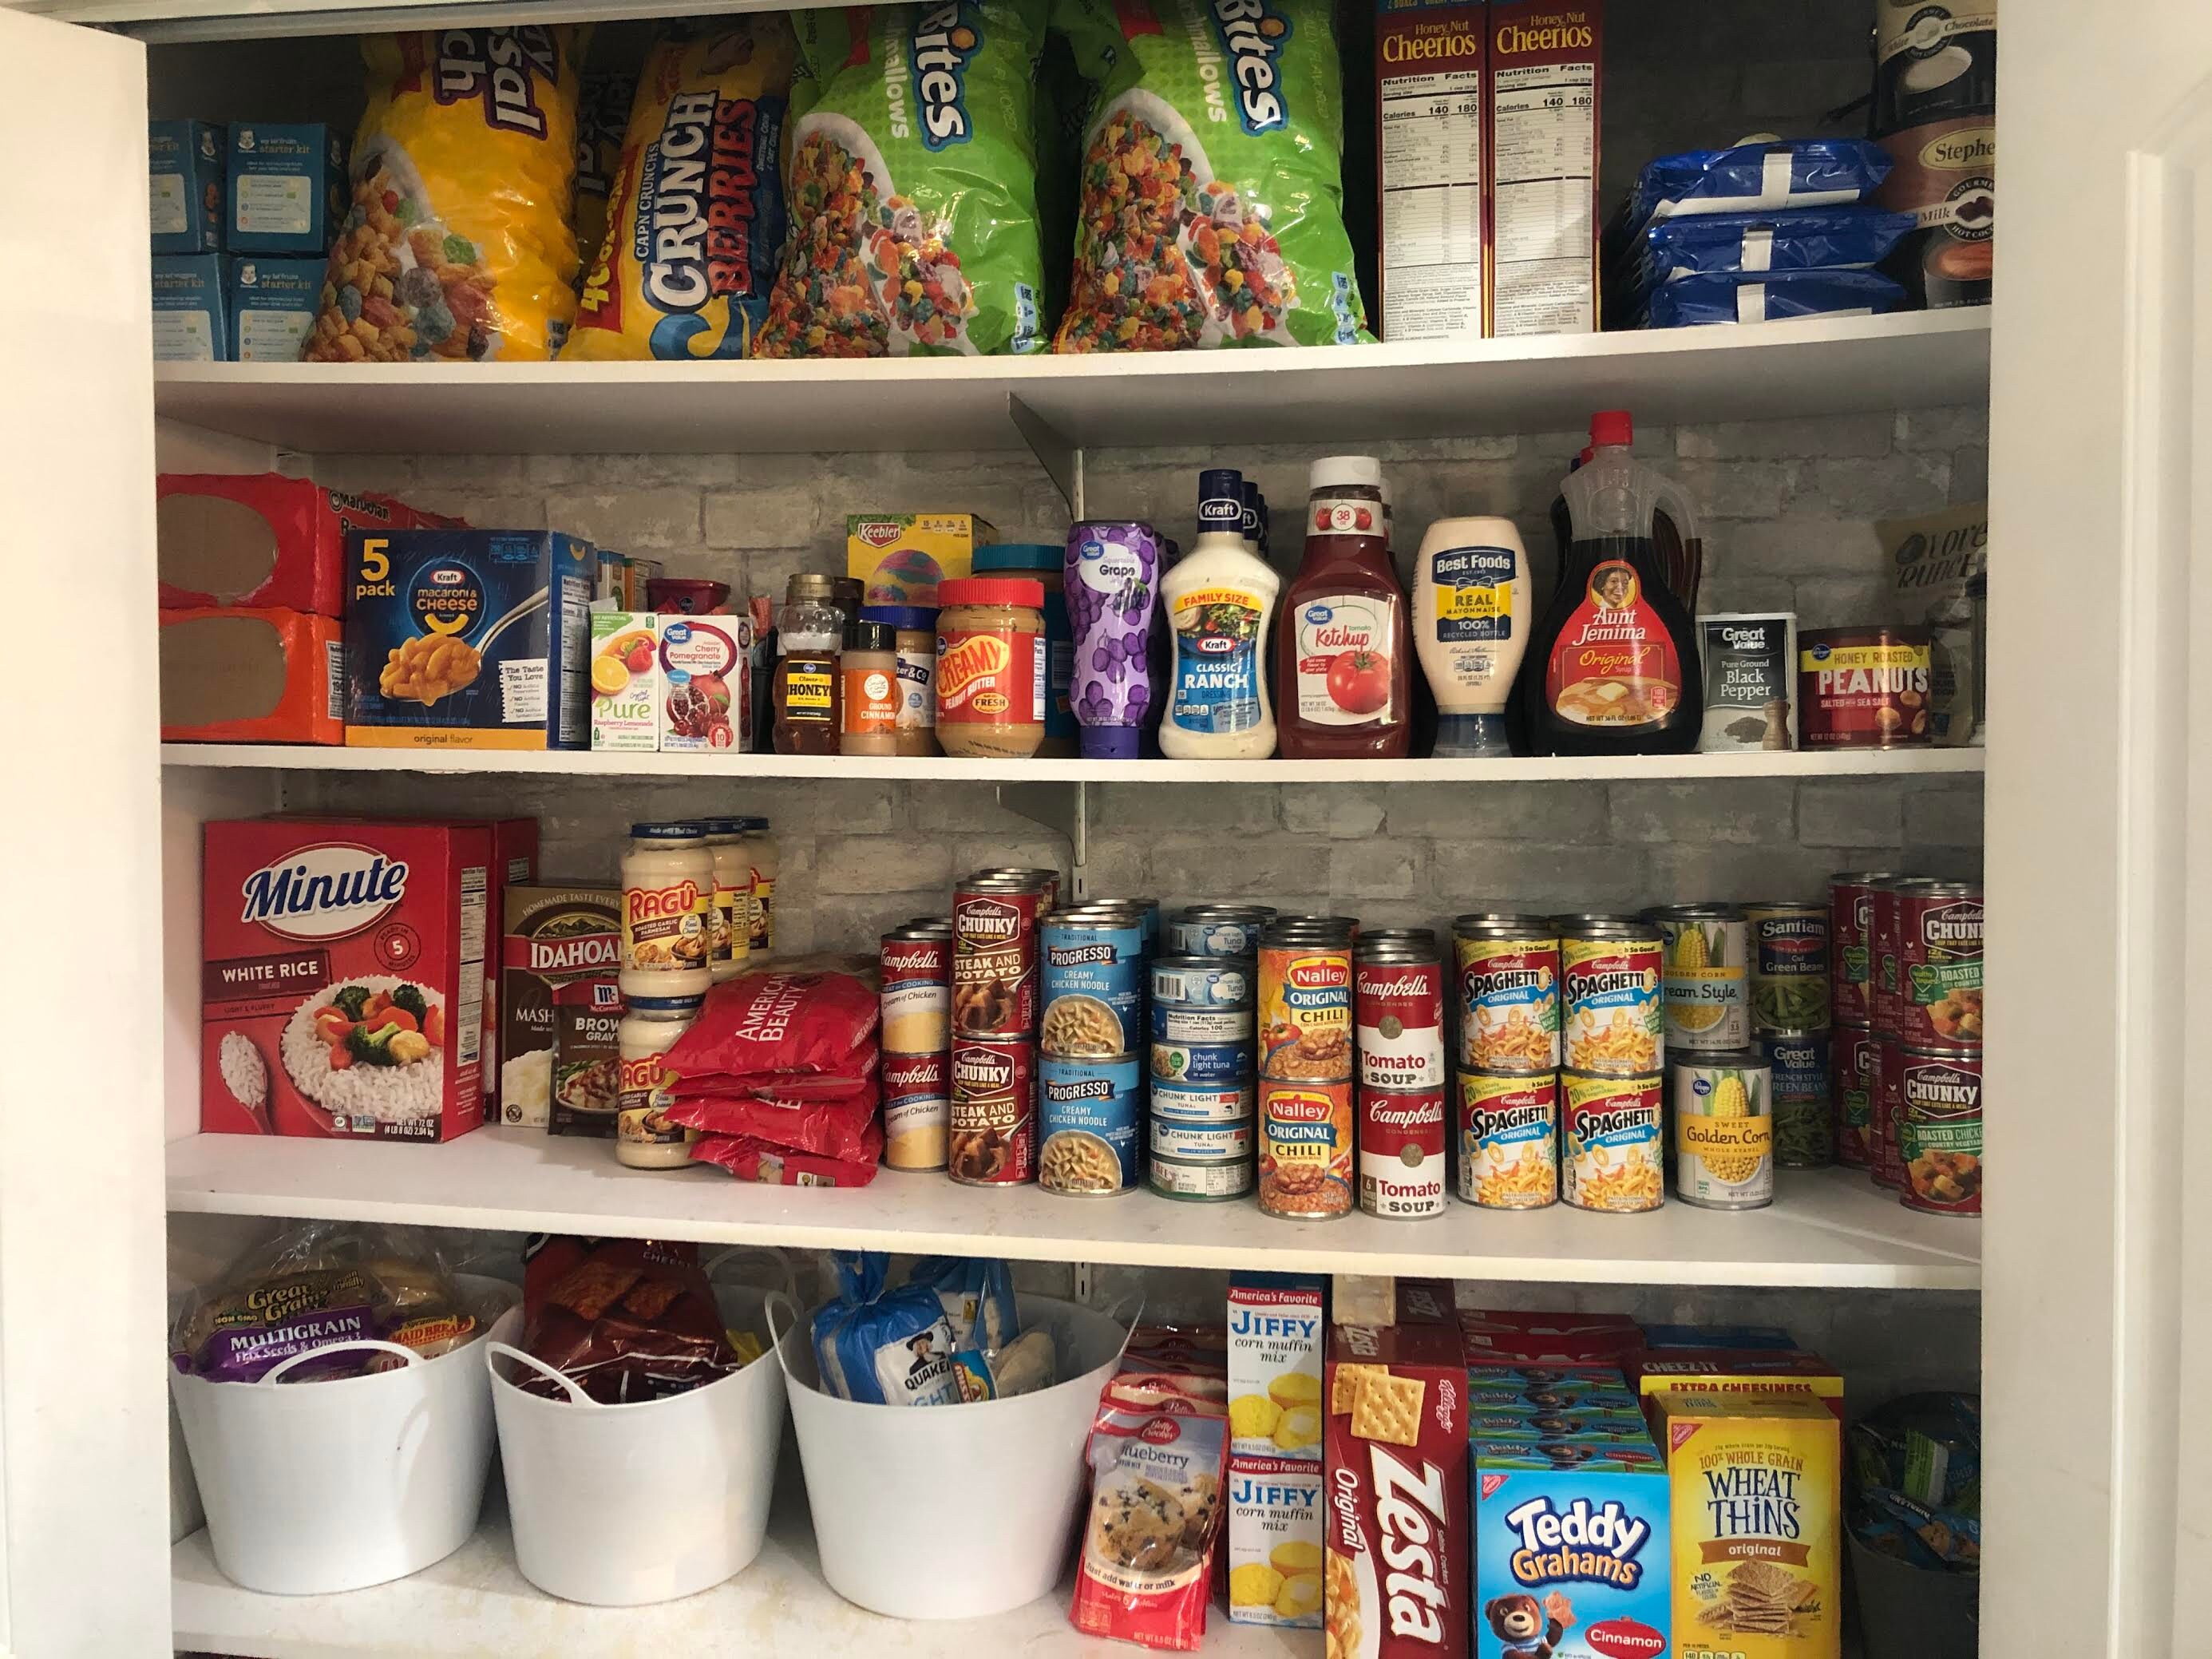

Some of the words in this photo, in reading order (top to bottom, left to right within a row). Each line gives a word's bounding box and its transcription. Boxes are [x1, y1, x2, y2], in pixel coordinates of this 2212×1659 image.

[1945, 18, 1993, 32] Chocolate
[1497, 26, 1593, 54] Cheerios
[1383, 34, 1476, 62] Cheerios
[1383, 75, 1434, 86] Nutrition
[1445, 72, 1477, 81] Facts
[1496, 66, 1549, 78] Nutrition
[1496, 103, 1529, 112] Calories
[1542, 97, 1563, 106] 140
[1572, 96, 1592, 105] 180
[1383, 110, 1415, 120] Calories
[1428, 105, 1449, 115] 140
[1457, 104, 1477, 113] 180
[1935, 138, 1995, 162] Stephe
[649, 92, 716, 307] CRUNCH
[707, 100, 758, 294] BERRIES
[1921, 207, 1950, 223] Milk
[1205, 503, 1234, 516] Kraft
[861, 525, 900, 541] Keebler
[361, 539, 390, 581] 5
[1437, 557, 1468, 573] Best
[1470, 555, 1510, 570] Foods
[437, 572, 457, 582] Kraft
[1099, 564, 1135, 579] Grape
[356, 582, 395, 600] pack
[417, 588, 469, 598] macaroni
[1184, 593, 1222, 606] FAMILY
[1225, 593, 1249, 605] SIZE
[1455, 594, 1493, 607] REAL
[1593, 606, 1637, 625] Aunt
[1458, 620, 1490, 630] 100%
[1316, 626, 1369, 652] Ketchup
[1572, 624, 1645, 646] Jemima
[695, 645, 720, 654] Cherry
[1205, 640, 1227, 649] Kraft
[1733, 639, 1765, 649] Value
[670, 652, 720, 661] Pomegranate
[1580, 647, 1650, 674] Original
[1834, 651, 1866, 664] HONEY
[938, 641, 1000, 693] CREAMY
[1185, 673, 1248, 689] RANCH
[1726, 669, 1764, 683] Black
[1818, 667, 1928, 695] PEANUTS
[1721, 683, 1771, 701] Pepper
[1821, 699, 1844, 707] SALTED
[414, 734, 448, 745] original
[450, 734, 473, 743] flavor
[243, 857, 406, 920] Minute
[523, 894, 567, 917] HOMEMADE
[569, 893, 593, 902] TASTE
[958, 915, 1016, 935] CHUNKY
[1763, 920, 1824, 936] Santiam
[531, 940, 620, 968] IDAHOA
[996, 954, 1020, 965] AND
[1051, 946, 1111, 965] PROGRESSO
[223, 964, 274, 983] WHITE
[280, 960, 319, 977] RICE
[956, 966, 1021, 980] POTATO
[1766, 962, 1796, 972] Green
[1064, 970, 1094, 980] CREAMY
[1297, 970, 1346, 985] Nalley
[902, 980, 934, 989] COOKING
[908, 991, 936, 1000] Chicken
[1290, 992, 1347, 1005] ORIGINAL
[1487, 992, 1529, 1003] ORIGINAL
[1592, 993, 1635, 1004] ORIGINAL
[1664, 985, 1698, 997] ream
[1702, 984, 1735, 1002] Style
[736, 973, 794, 1042] AMERICAN
[760, 986, 808, 1042] BEAUTY
[516, 1008, 554, 1023] MASH
[1300, 1009, 1343, 1023] CHILI
[1193, 1052, 1217, 1062] chunk
[1363, 1051, 1425, 1069] Tomato
[1774, 1047, 1815, 1060] Great
[1193, 1060, 1211, 1070] light
[1784, 1059, 1815, 1068] Value
[955, 1061, 1010, 1083] CHUNKY
[1059, 1068, 1094, 1077] TRADITIONAL
[1371, 1073, 1417, 1084] SOUP
[904, 1094, 935, 1103] COOKING
[1048, 1083, 1108, 1101] PROGRESSO
[1907, 1079, 1977, 1104] CHUNKY
[989, 1103, 1015, 1114] AND
[1272, 1103, 1325, 1119] Nalley
[1049, 1115, 1076, 1124] CHICKEN
[1170, 1131, 1201, 1141] CHUNK
[1206, 1131, 1233, 1140] LIGHT
[1268, 1124, 1330, 1140] ORIGINAL
[1501, 1127, 1540, 1140] ORIGINAL
[1605, 1131, 1646, 1143] ORIGINAL
[1687, 1126, 1739, 1144] Golden
[1743, 1126, 1770, 1144] Corn
[1276, 1145, 1321, 1156] CHILI
[1379, 1180, 1440, 1198] Tomato
[1389, 1201, 1434, 1213] SOUP
[1231, 1310, 1316, 1339] JIFFY
[230, 1316, 361, 1352] MULTIGRAIN
[1235, 1338, 1264, 1349] corn
[1268, 1339, 1312, 1352] muffin
[1260, 1352, 1288, 1364] mix
[1670, 1382, 1719, 1392] EXTRA
[1122, 1444, 1189, 1469] lueberry
[1703, 1466, 1801, 1500] WHEAT
[1233, 1479, 1318, 1507] JIFFY
[1236, 1507, 1265, 1518] corn
[1268, 1507, 1314, 1521] muffin
[1335, 1468, 1366, 1552] Original
[1261, 1519, 1288, 1532] mix
[1507, 1499, 1645, 1558] Teddy
[1369, 1444, 1446, 1643] Zesta
[1729, 1544, 1781, 1557] original
[1513, 1546, 1637, 1585] Grahams
[1102, 1573, 1118, 1584] add
[1695, 1573, 1711, 1582] NO
[1590, 1629, 1662, 1649] Cinnamon
